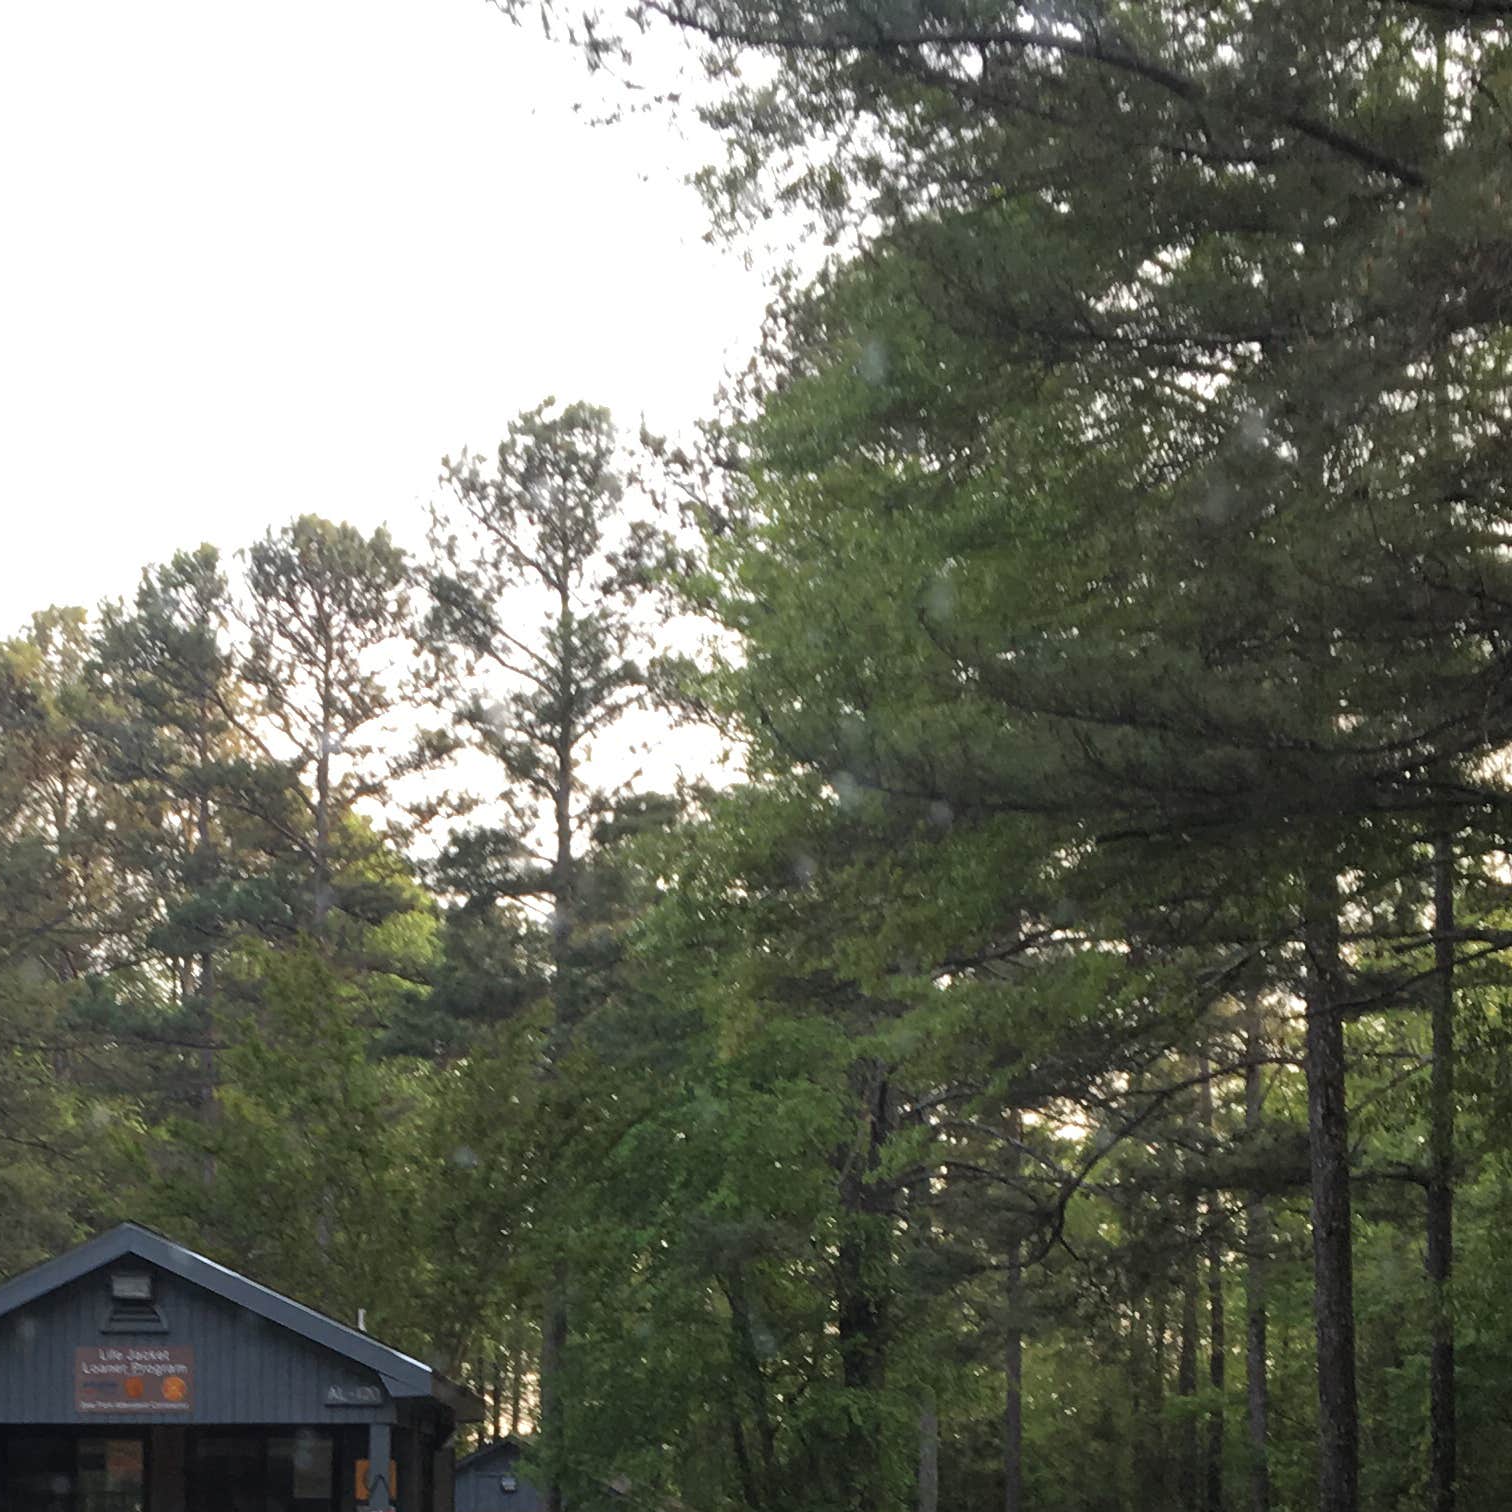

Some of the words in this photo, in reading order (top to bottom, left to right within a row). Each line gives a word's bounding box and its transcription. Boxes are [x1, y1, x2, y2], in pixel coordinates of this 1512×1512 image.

[98, 1348, 123, 1361] Life
[126, 1348, 170, 1361] Jacket
[131, 1362, 188, 1377] Program
